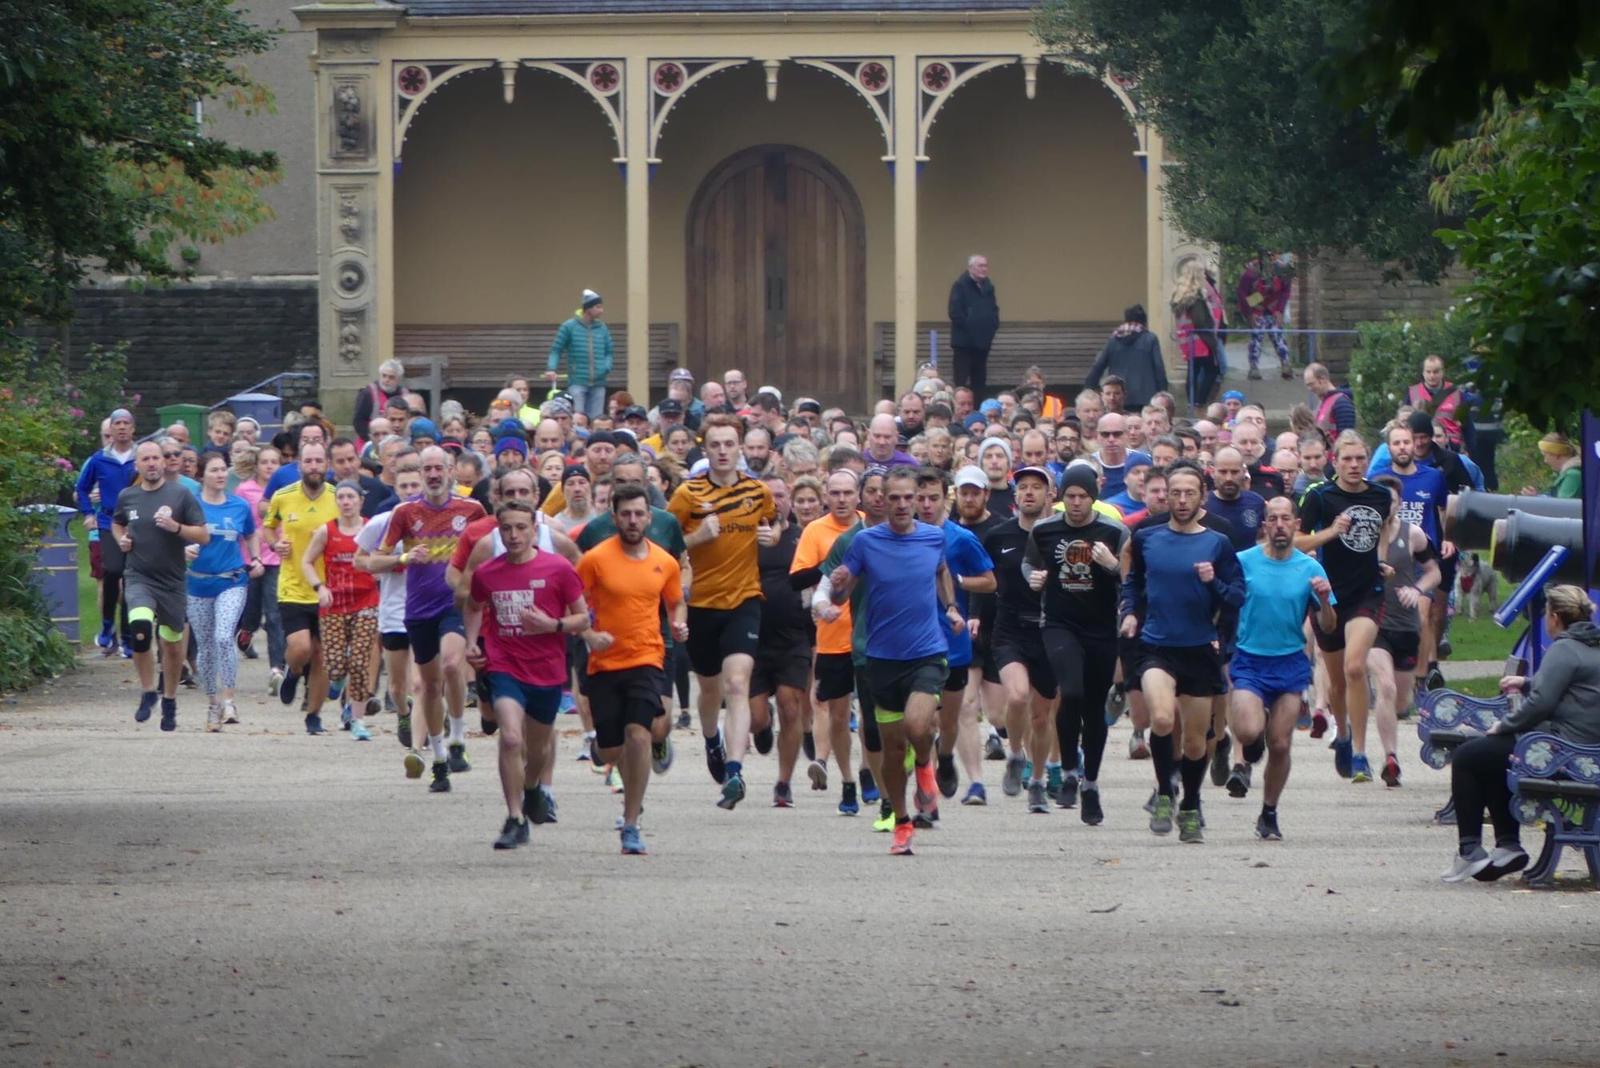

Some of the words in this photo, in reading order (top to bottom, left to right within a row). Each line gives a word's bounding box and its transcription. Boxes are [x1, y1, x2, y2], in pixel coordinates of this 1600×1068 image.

[1410, 501, 1425, 510] UK
[1396, 510, 1424, 521] EEDS
[1054, 538, 1069, 565] LEEDS
